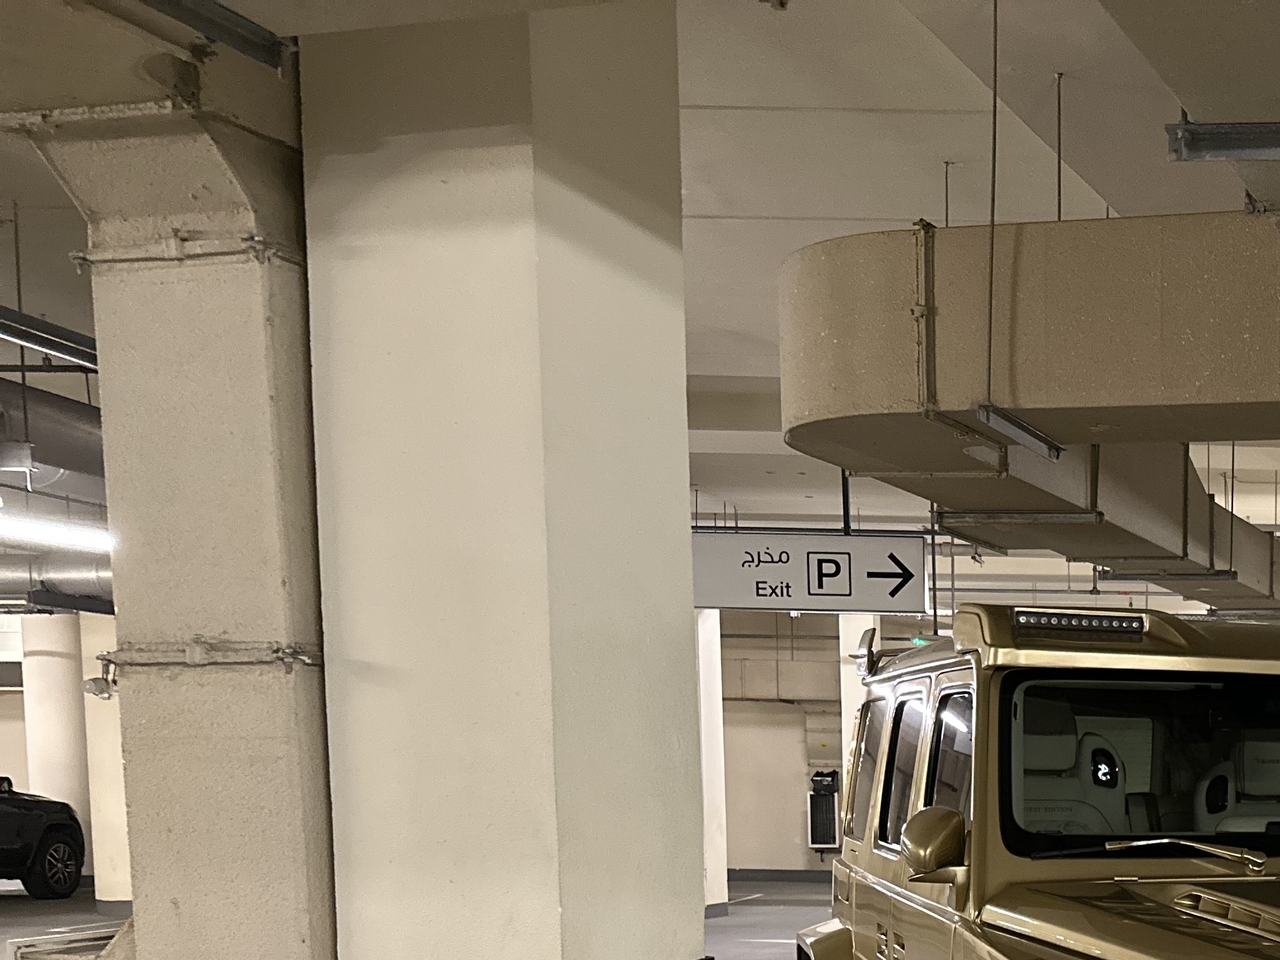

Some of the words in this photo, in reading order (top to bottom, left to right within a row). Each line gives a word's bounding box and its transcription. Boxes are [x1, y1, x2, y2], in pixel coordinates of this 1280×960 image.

[741, 546, 790, 568] مخرج
[816, 558, 842, 590] P
[755, 580, 792, 598] Exit
